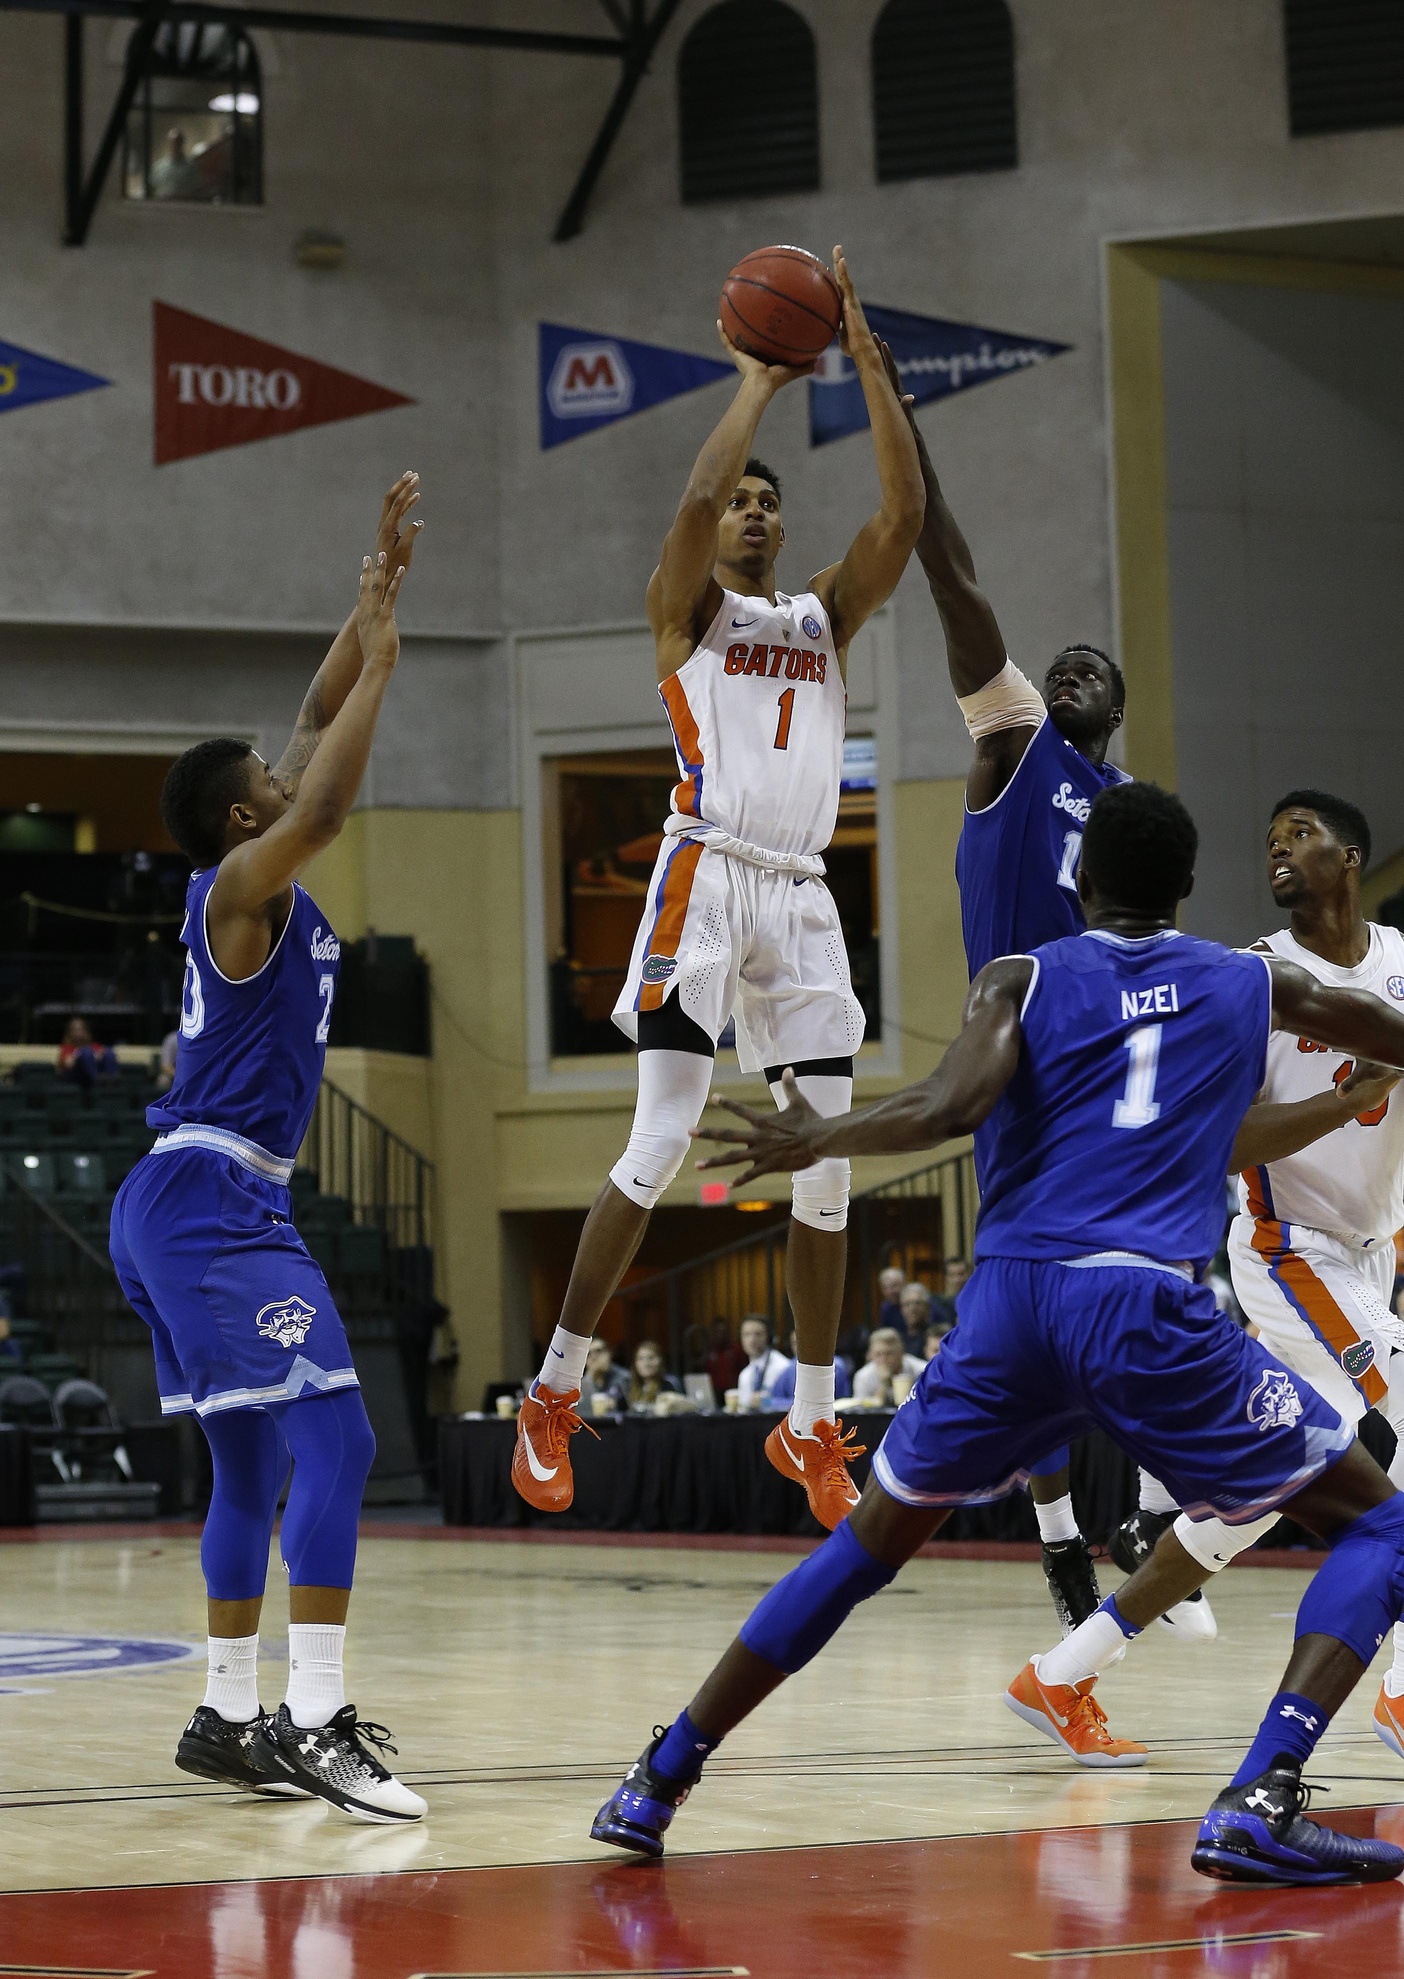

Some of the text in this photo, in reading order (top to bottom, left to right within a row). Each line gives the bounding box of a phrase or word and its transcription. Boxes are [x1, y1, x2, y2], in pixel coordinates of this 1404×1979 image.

[168, 362, 301, 410] TORO
[565, 355, 616, 390] M
[723, 642, 828, 685] GATORS
[773, 687, 796, 751] 1
[1121, 983, 1179, 1020] NZEI
[1388, 976, 1404, 999] SE
[1111, 1023, 1163, 1129] 1
